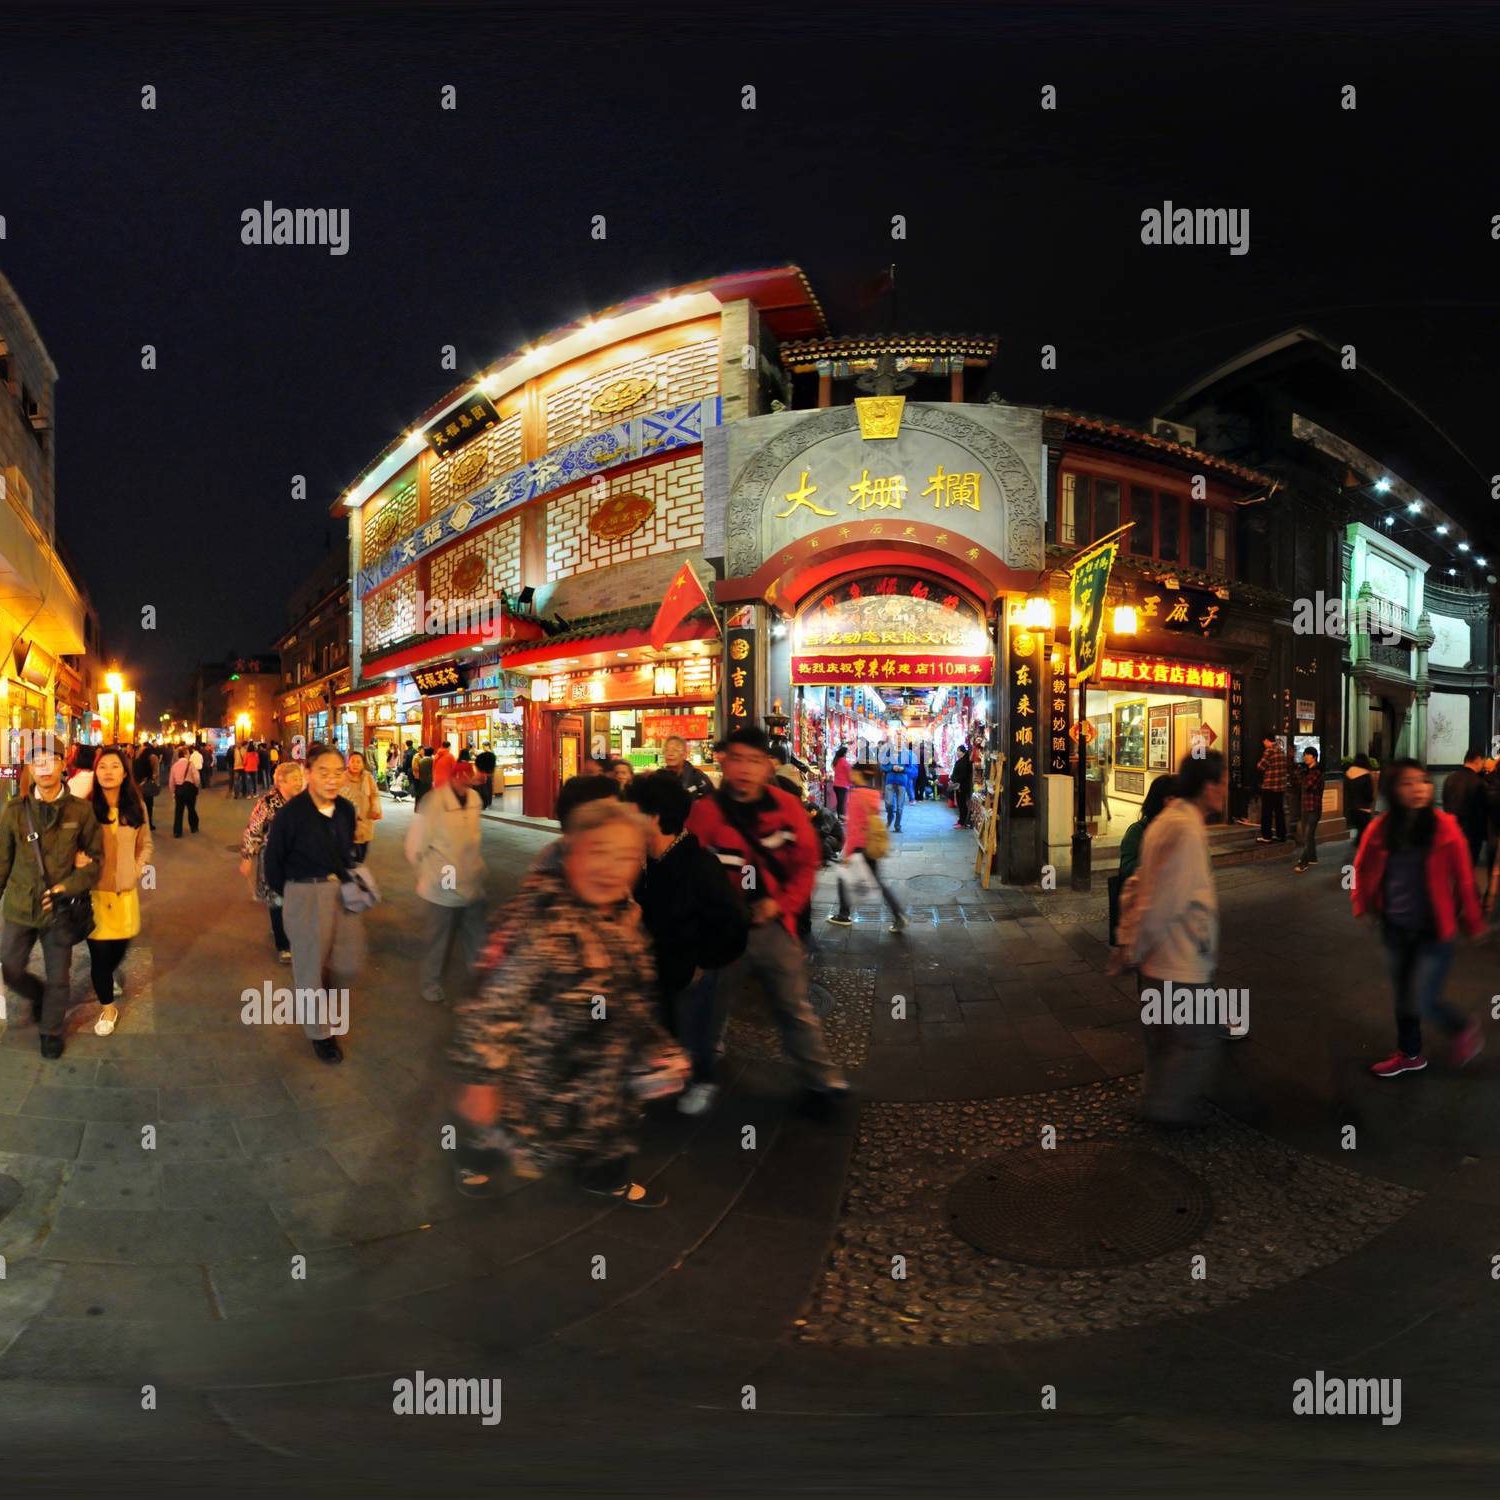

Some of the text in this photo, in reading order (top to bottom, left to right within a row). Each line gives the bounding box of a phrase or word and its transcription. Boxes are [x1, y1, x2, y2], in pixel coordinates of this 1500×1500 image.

[433, 404, 487, 447] 天福集团
[1139, 595, 1220, 629] 王麻子
[415, 668, 460, 690] 天福茗茶
[730, 666, 748, 733] 吉龙
[1014, 664, 1035, 809] 东来顺饭庄
